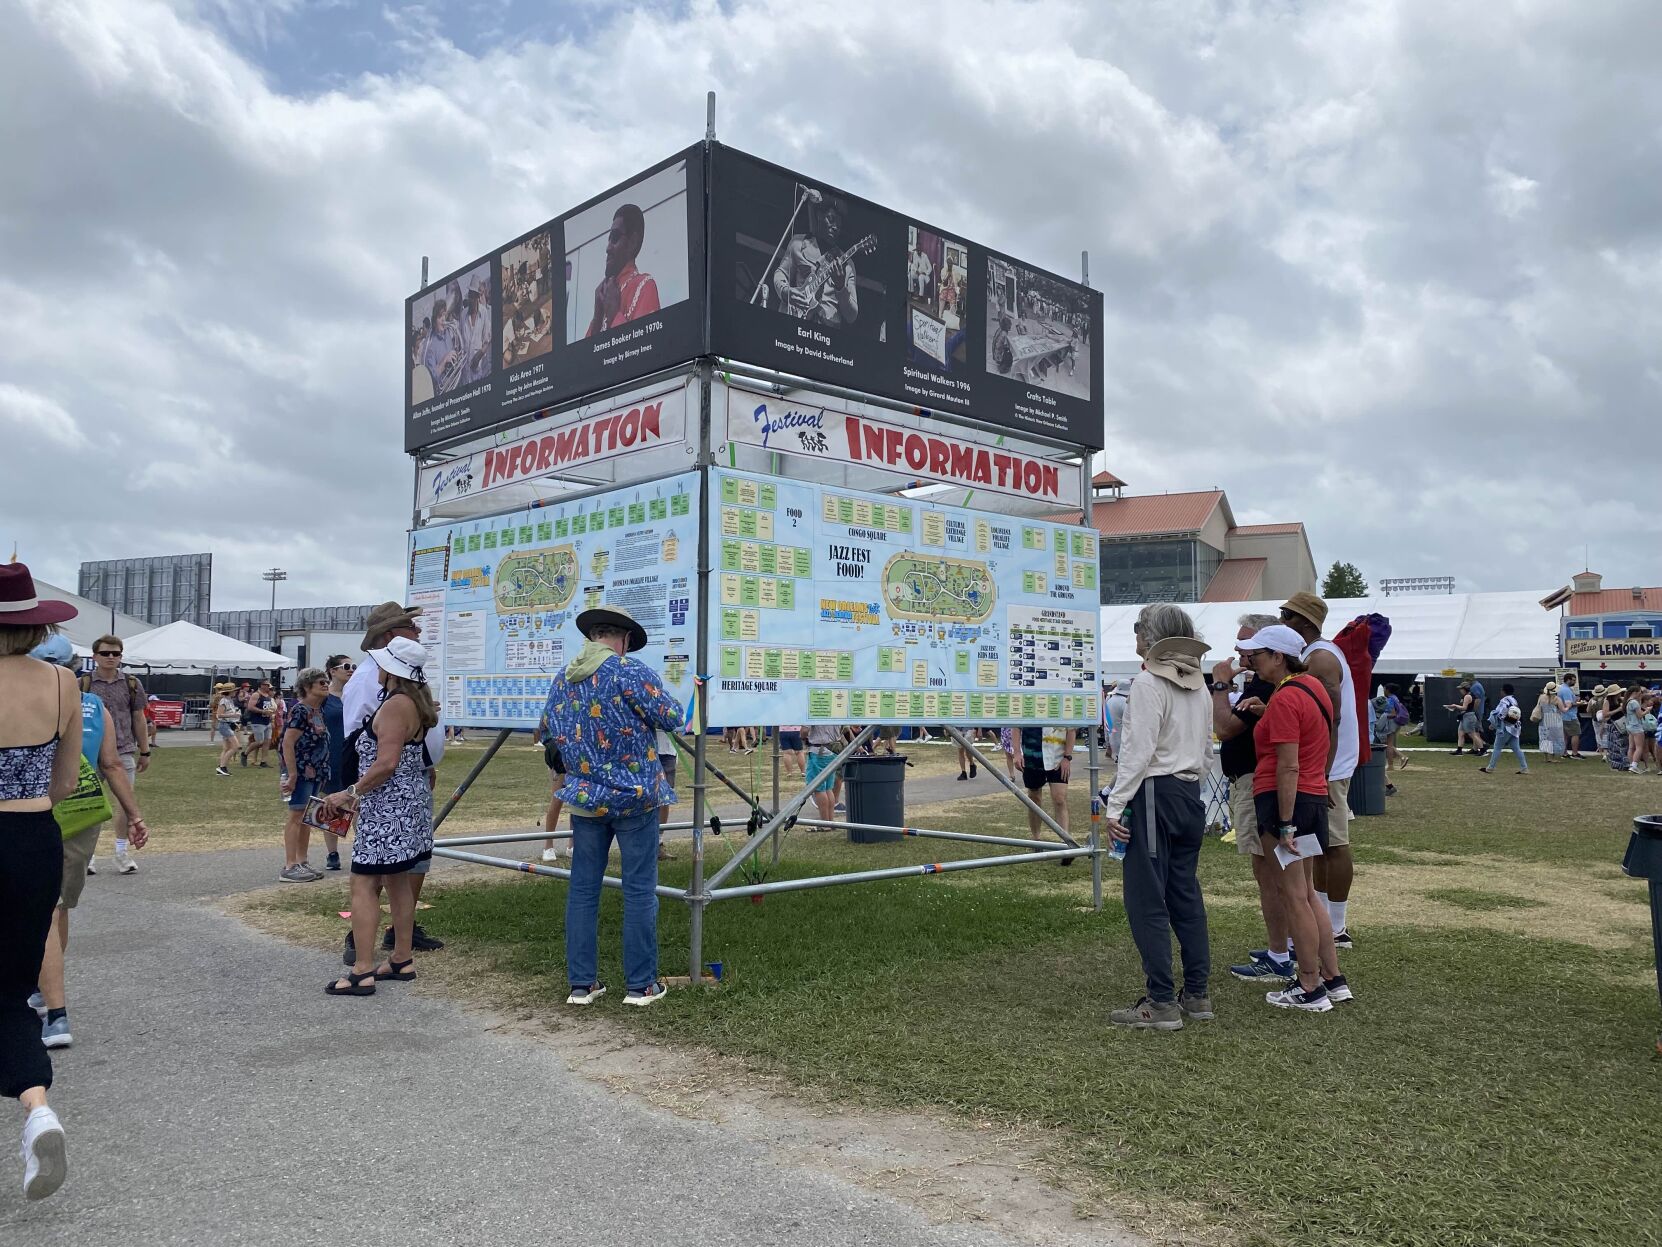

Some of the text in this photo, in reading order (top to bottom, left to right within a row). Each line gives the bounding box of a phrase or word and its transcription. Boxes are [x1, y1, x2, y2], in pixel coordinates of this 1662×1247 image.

[593, 321, 663, 352] James Booker late 1970s
[797, 327, 830, 346] Earl King
[603, 356, 617, 365] Image
[618, 353, 624, 361] by
[775, 339, 854, 367] Image by David Sutherland
[510, 363, 544, 383] Kids Area 1971
[903, 366, 971, 392] Spiritual Walkers 1996
[450, 392, 473, 405] Preservation
[473, 387, 481, 397] Hall
[904, 383, 921, 394] Image
[922, 387, 928, 396] by
[1026, 391, 1057, 406] Crafts Table
[1015, 403, 1029, 413] Image
[432, 401, 663, 504] Festival INFORMATION
[754, 403, 825, 448] Festival
[845, 416, 1059, 498] INFORMATION
[786, 507, 803, 519] FOOD
[792, 519, 797, 528] 2
[866, 530, 887, 541] SQUARE
[829, 544, 850, 561] JAZZ
[851, 547, 871, 563] FEST
[836, 561, 864, 579] FOOD!
[820, 599, 836, 610] NEW
[1599, 643, 1660, 656] LEMONADE
[721, 680, 778, 692] HERITAGE SQUARE
[930, 677, 942, 686] FOOD
[1141, 1010, 1151, 1019] N
